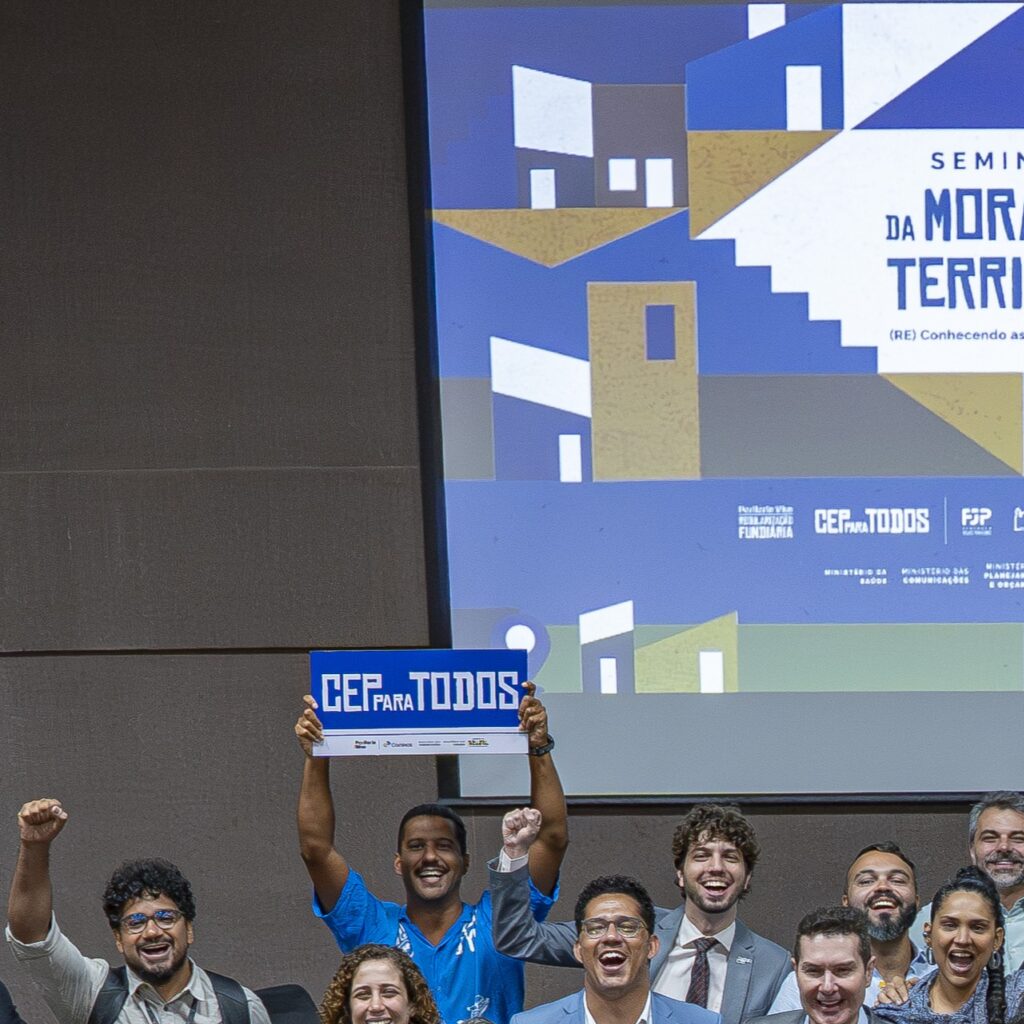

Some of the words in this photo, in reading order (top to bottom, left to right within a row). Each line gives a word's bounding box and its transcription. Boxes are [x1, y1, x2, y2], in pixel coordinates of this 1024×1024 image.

[885, 214, 915, 241] DA
[889, 329, 917, 341] (RE)
[920, 329, 1007, 340] Conhecendo
[814, 509, 850, 534] CEP
[844, 520, 870, 534] PARA
[865, 507, 930, 534] TODOS
[961, 507, 992, 526] FJP
[321, 673, 383, 712] CEP
[373, 693, 414, 711] PARA
[409, 671, 519, 711] TODOS
